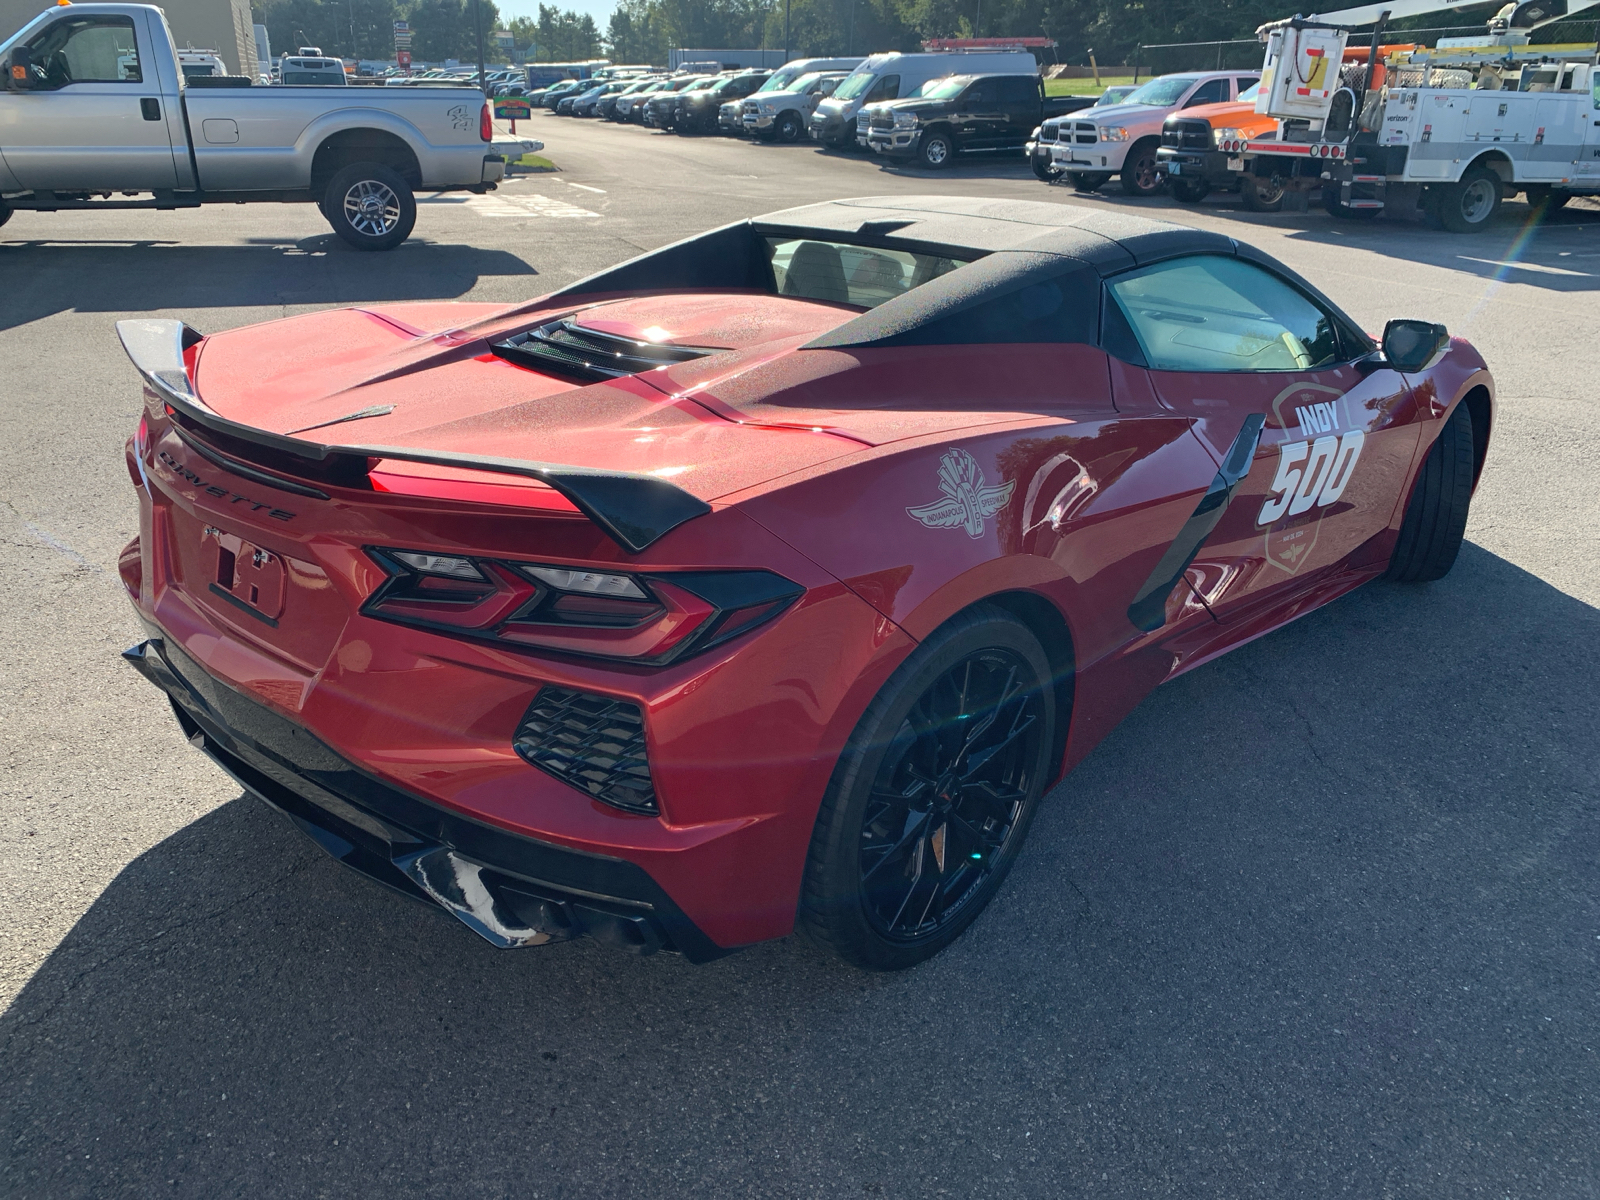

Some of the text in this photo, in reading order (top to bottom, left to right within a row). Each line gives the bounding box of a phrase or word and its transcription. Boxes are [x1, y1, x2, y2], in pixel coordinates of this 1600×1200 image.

[1295, 401, 1339, 436] INDY
[158, 452, 297, 521] CORVETTE
[1258, 430, 1365, 526] 500
[926, 506, 964, 523] INDIANAPOLIS
[966, 488, 982, 529] MOTOR
[981, 493, 1006, 508] SPEEDWAY
